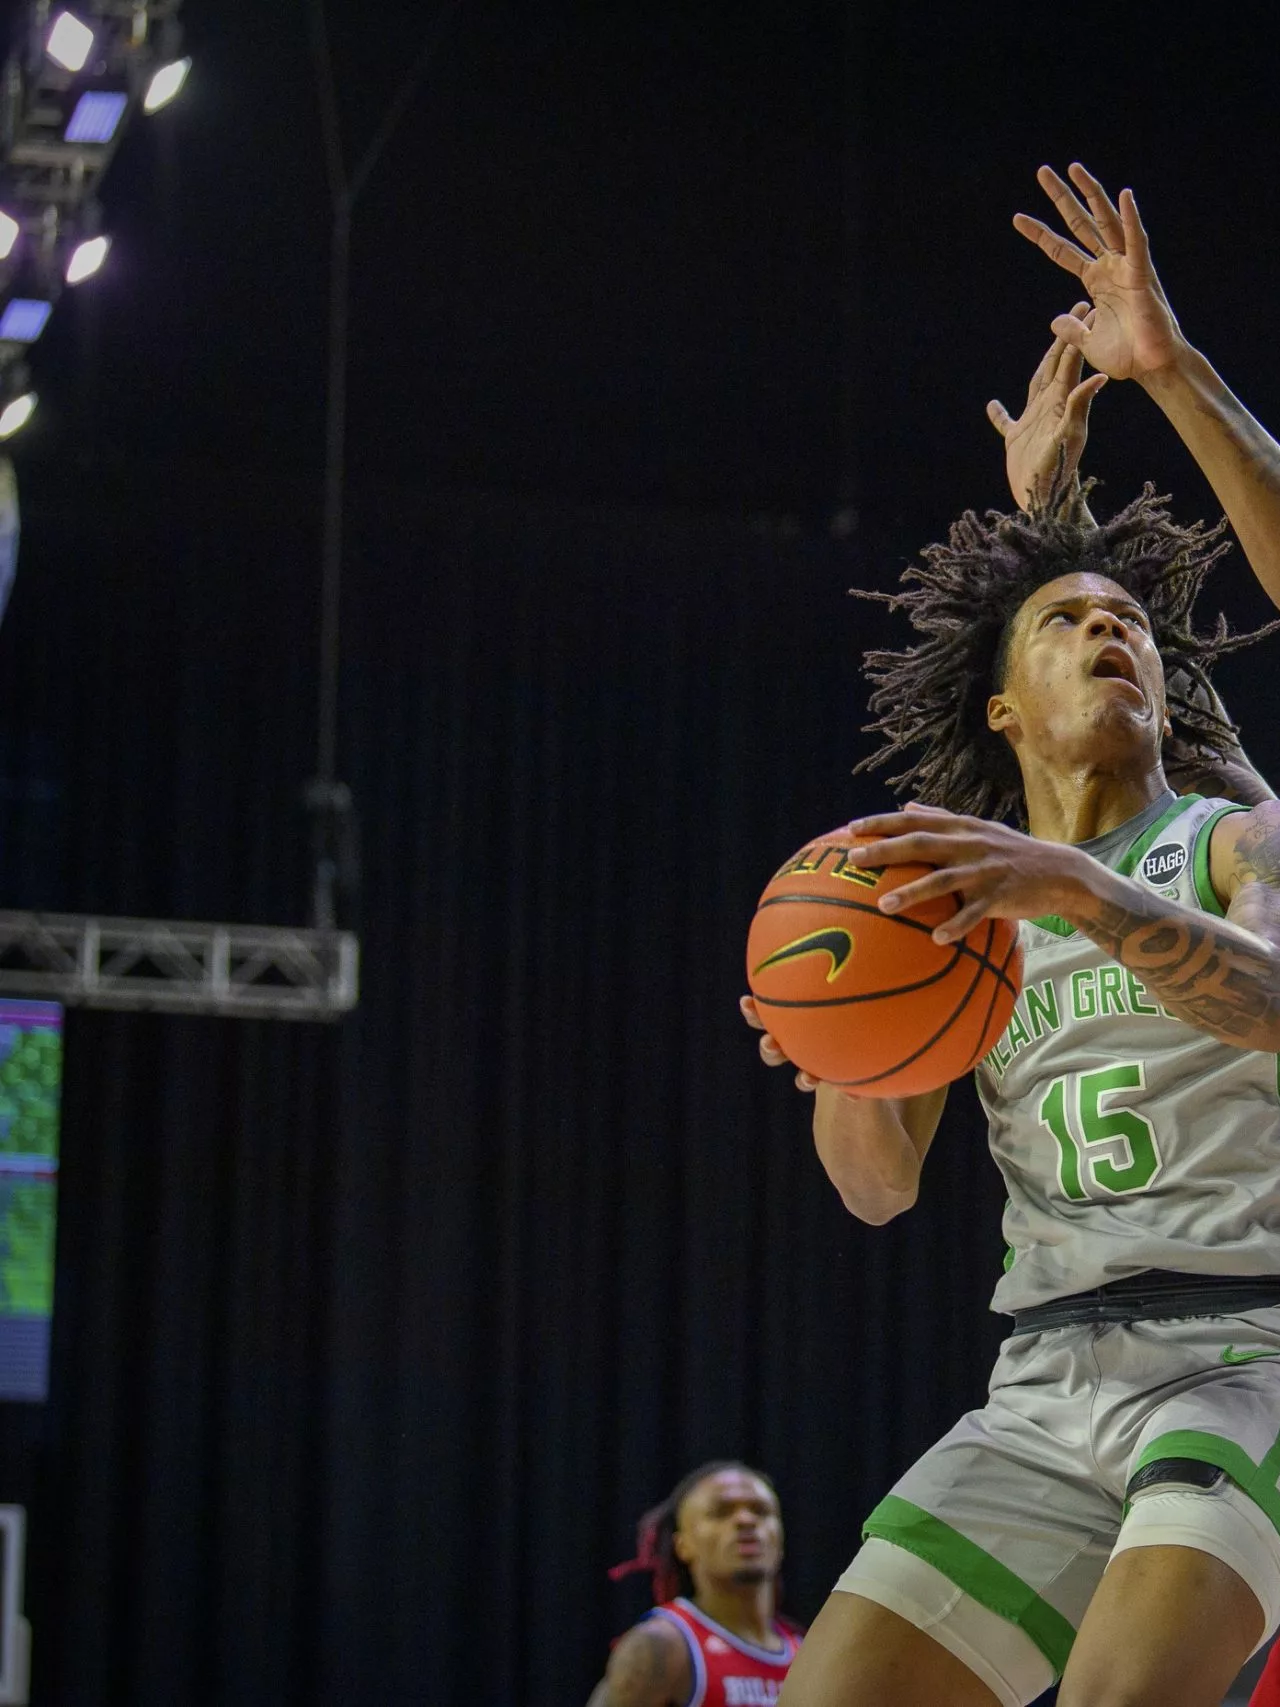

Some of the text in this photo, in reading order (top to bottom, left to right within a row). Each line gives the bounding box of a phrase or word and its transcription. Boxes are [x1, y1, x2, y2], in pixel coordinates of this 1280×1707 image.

[1145, 849, 1184, 877] HAGG
[1070, 965, 1183, 1022] GRE
[1038, 1059, 1163, 1202] 15
